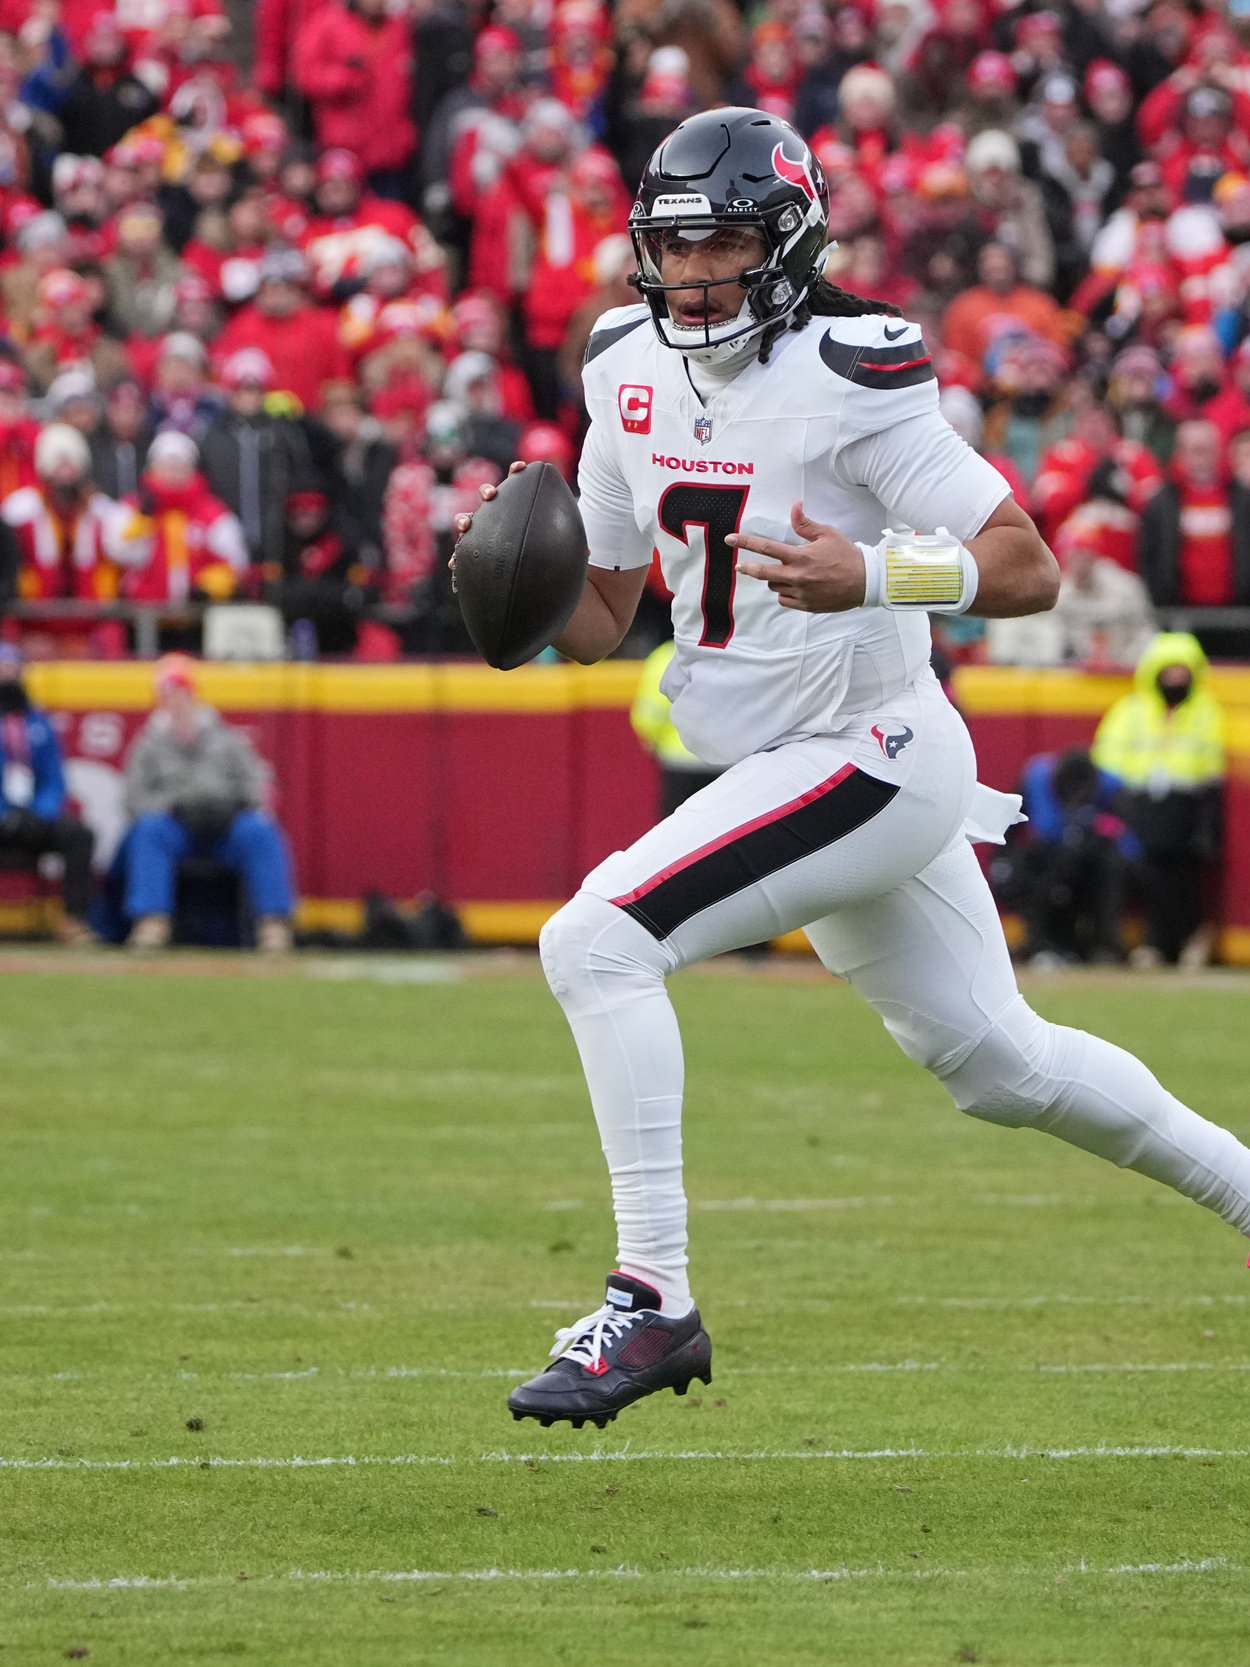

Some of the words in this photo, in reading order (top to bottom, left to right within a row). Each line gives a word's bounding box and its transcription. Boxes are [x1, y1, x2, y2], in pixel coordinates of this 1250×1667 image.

[657, 197, 703, 205] TEXANS
[620, 387, 650, 421] C
[652, 453, 754, 475] HOUSTON
[658, 481, 751, 649] 7
